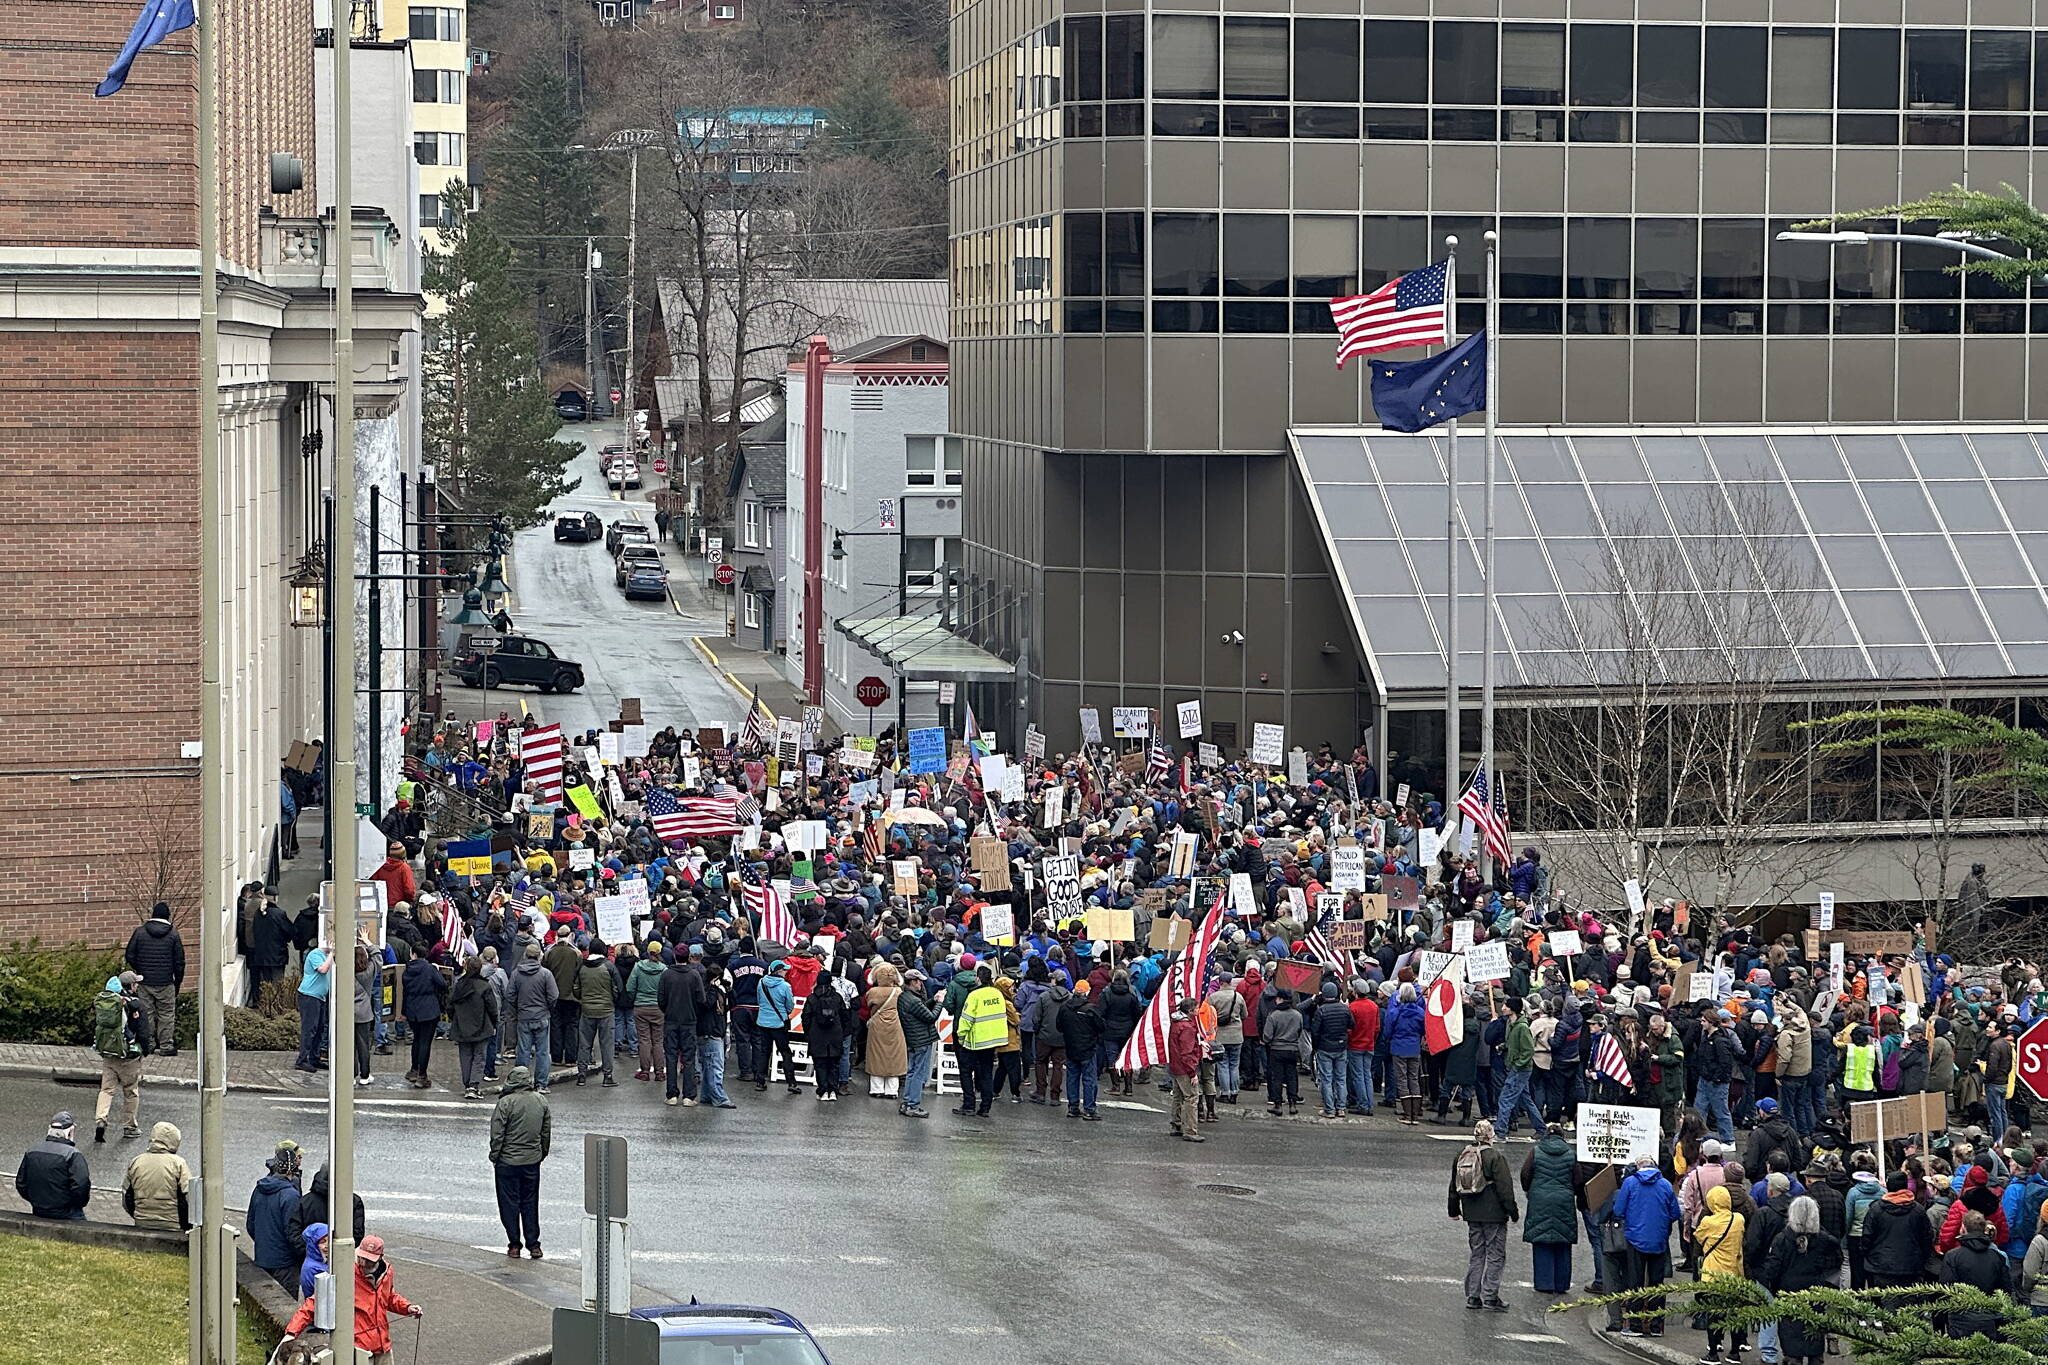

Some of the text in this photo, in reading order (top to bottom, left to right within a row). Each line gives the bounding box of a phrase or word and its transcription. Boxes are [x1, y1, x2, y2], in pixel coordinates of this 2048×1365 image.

[858, 686, 886, 697] STOP
[804, 707, 823, 720] BAD
[1114, 709, 1146, 718] SOLIDARITY
[1335, 851, 1357, 859] PROUD
[1046, 857, 1076, 878] GET IN
[1334, 862, 1364, 870] AMERICAN
[1048, 878, 1080, 900] GOOD
[1323, 898, 1339, 906] FOR
[1049, 898, 1083, 919] TROUBLE
[1330, 922, 1363, 935] STAND
[1328, 934, 1364, 949] TOGETHER
[1426, 953, 1449, 963] ALASKA
[1470, 956, 1494, 964] DONALD
[984, 998, 1000, 1006] POLICE
[1614, 1111, 1634, 1120] Rights
